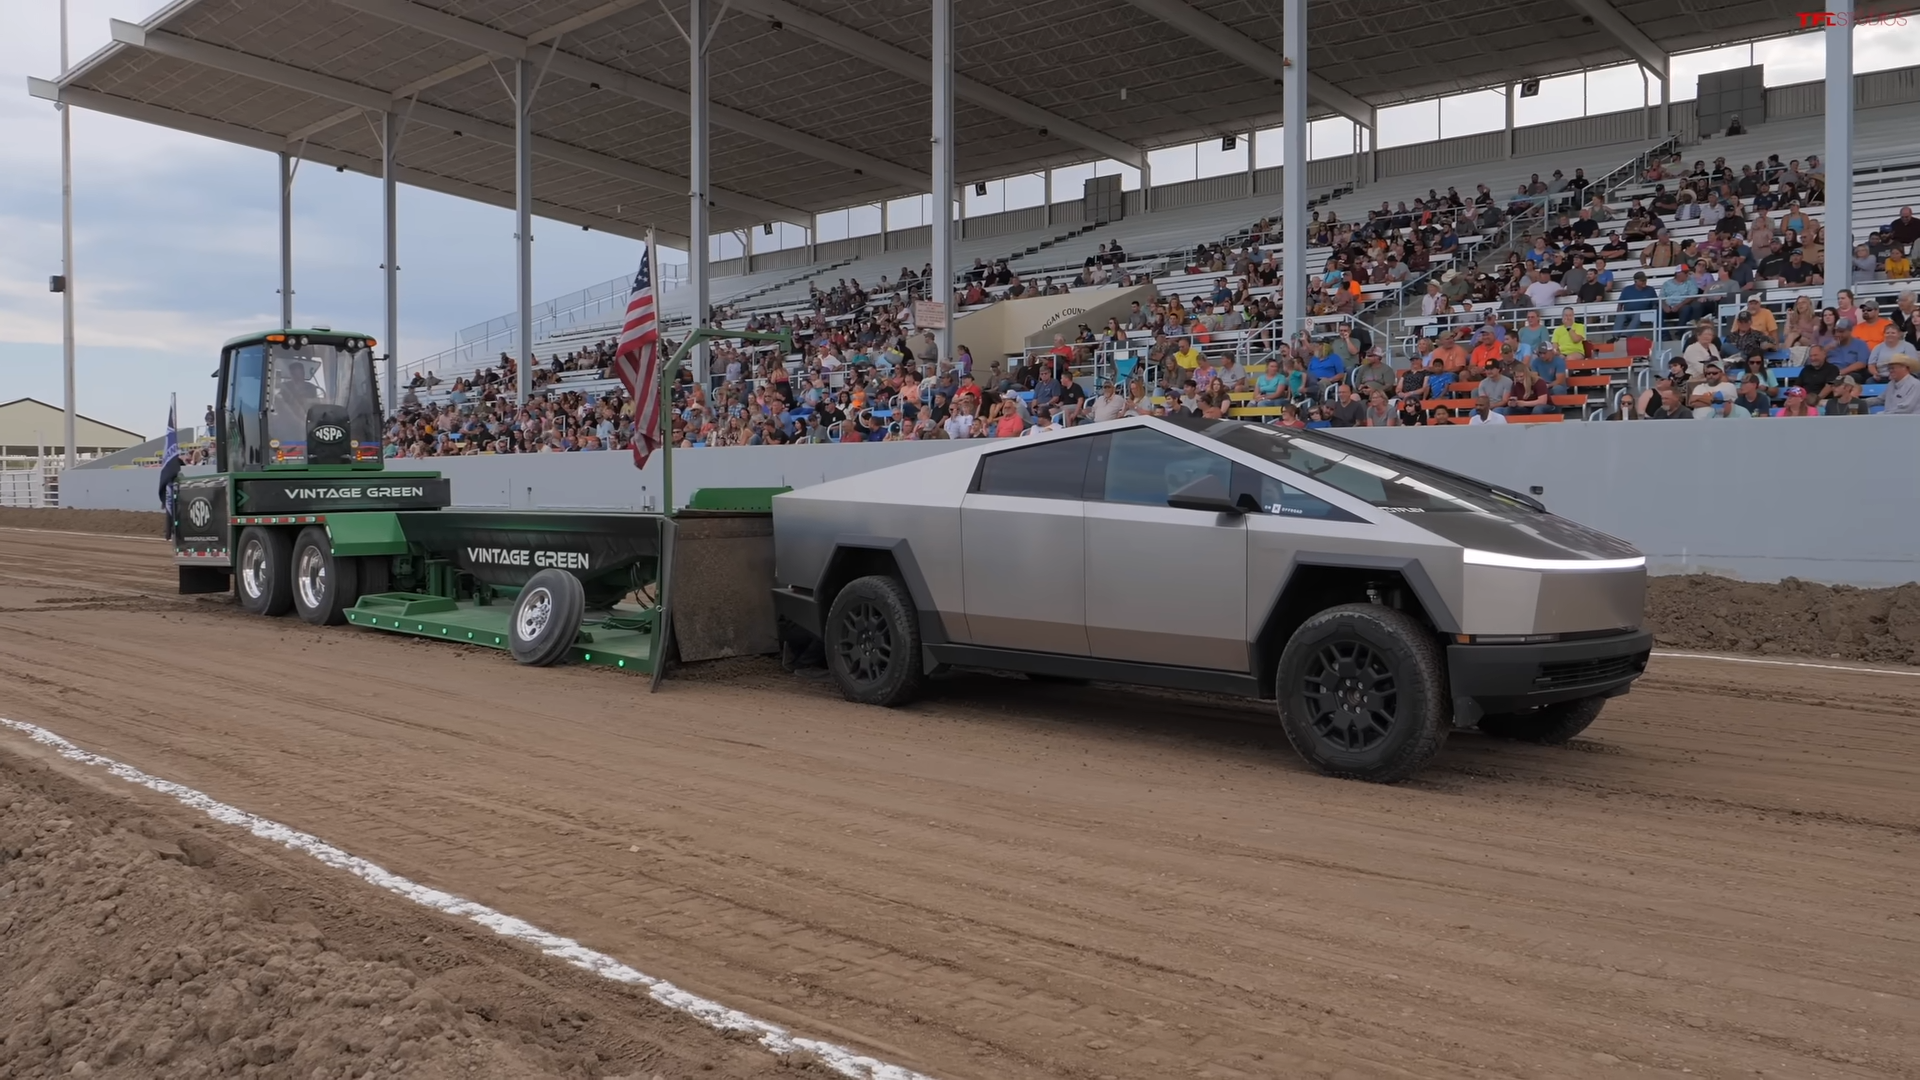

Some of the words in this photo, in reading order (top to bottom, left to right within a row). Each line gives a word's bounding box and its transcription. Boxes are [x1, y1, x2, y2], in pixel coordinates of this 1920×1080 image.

[1523, 82, 1537, 95] G
[1224, 137, 1234, 149] E
[976, 183, 985, 194] C
[765, 223, 772, 233] A
[1042, 312, 1060, 330] OGAN
[1062, 307, 1086, 317] COUNT
[315, 427, 343, 441] NSPA
[284, 487, 362, 499] VINTAGE
[366, 486, 424, 498] GREEN
[190, 501, 210, 526] NSPA
[467, 547, 530, 566] VINTAGE
[534, 550, 589, 569] GREEN
